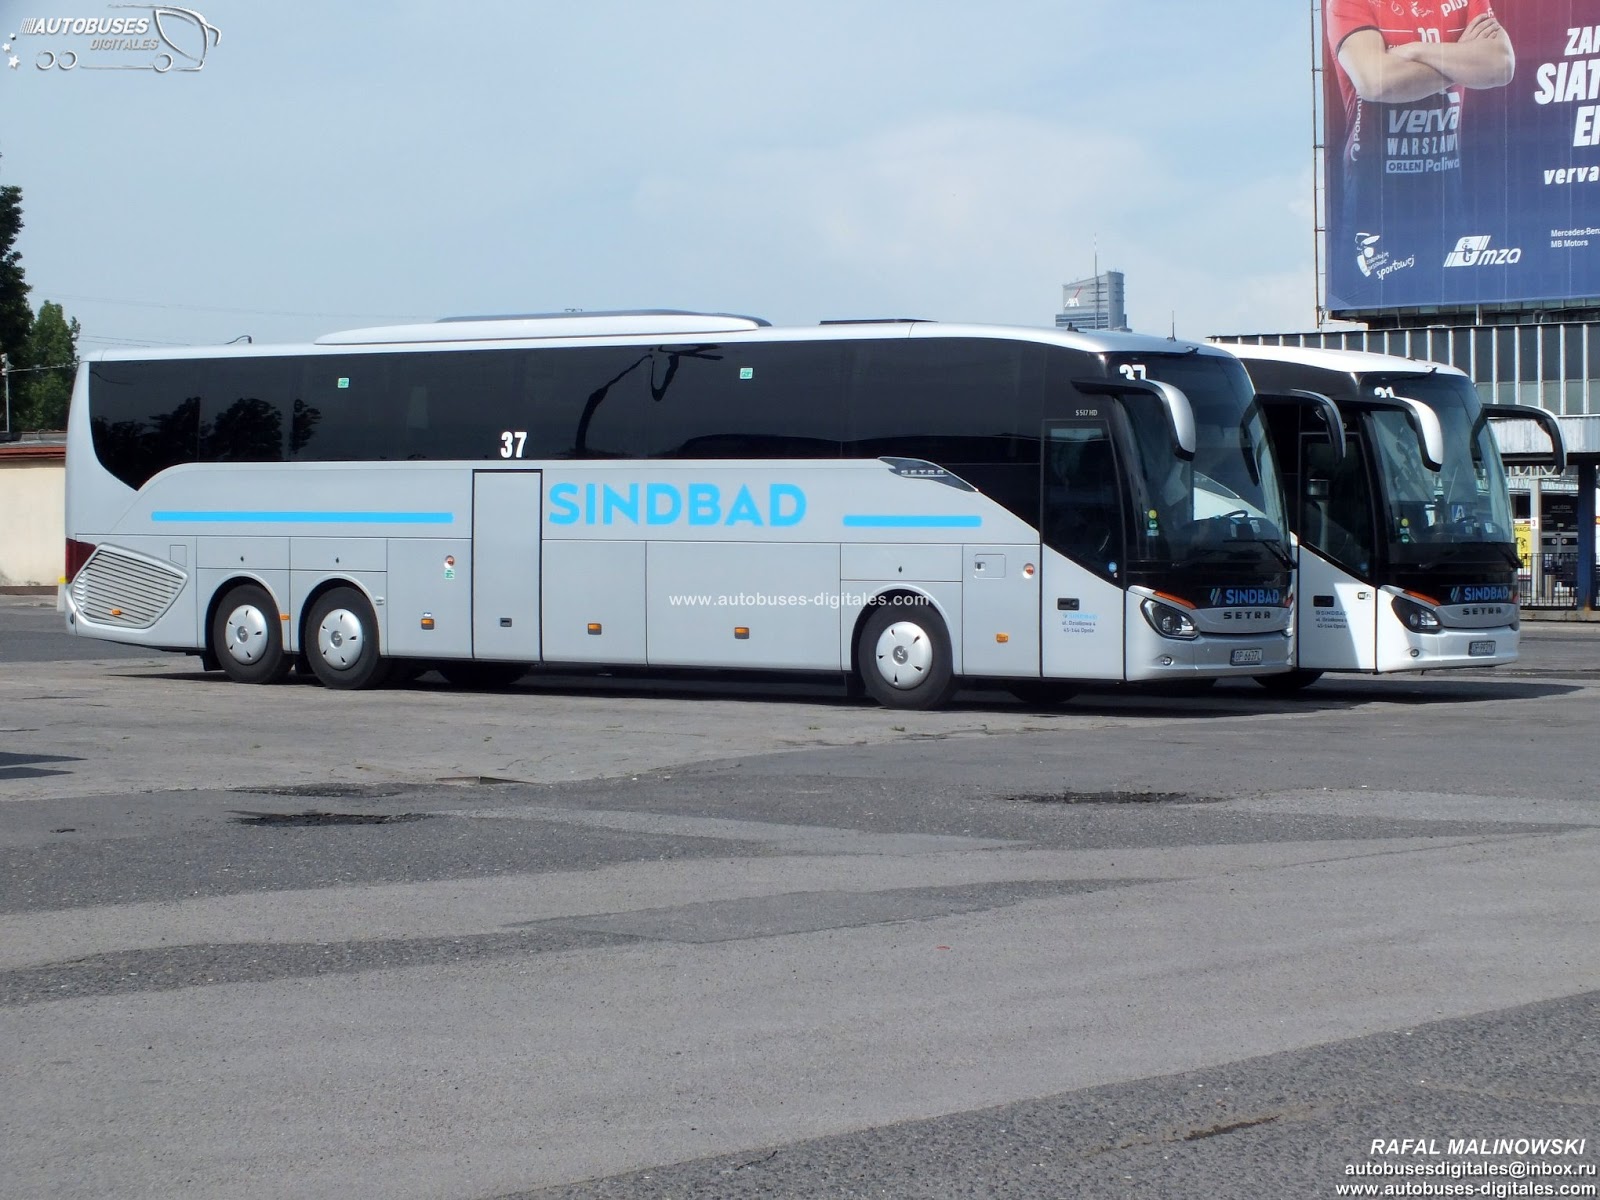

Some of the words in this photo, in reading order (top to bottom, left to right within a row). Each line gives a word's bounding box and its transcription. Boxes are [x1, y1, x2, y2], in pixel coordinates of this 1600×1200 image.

[1388, 162, 1421, 172] ORLEN
[1551, 240, 1563, 248] MB
[1564, 239, 1589, 247] Motors
[500, 431, 527, 459] 37
[548, 482, 807, 527] SINDBAD
[1226, 588, 1279, 605] SINDBAD
[1464, 586, 1508, 601] SINDBAD
[1223, 611, 1271, 620] SETRA
[1462, 607, 1502, 616] SETRA
